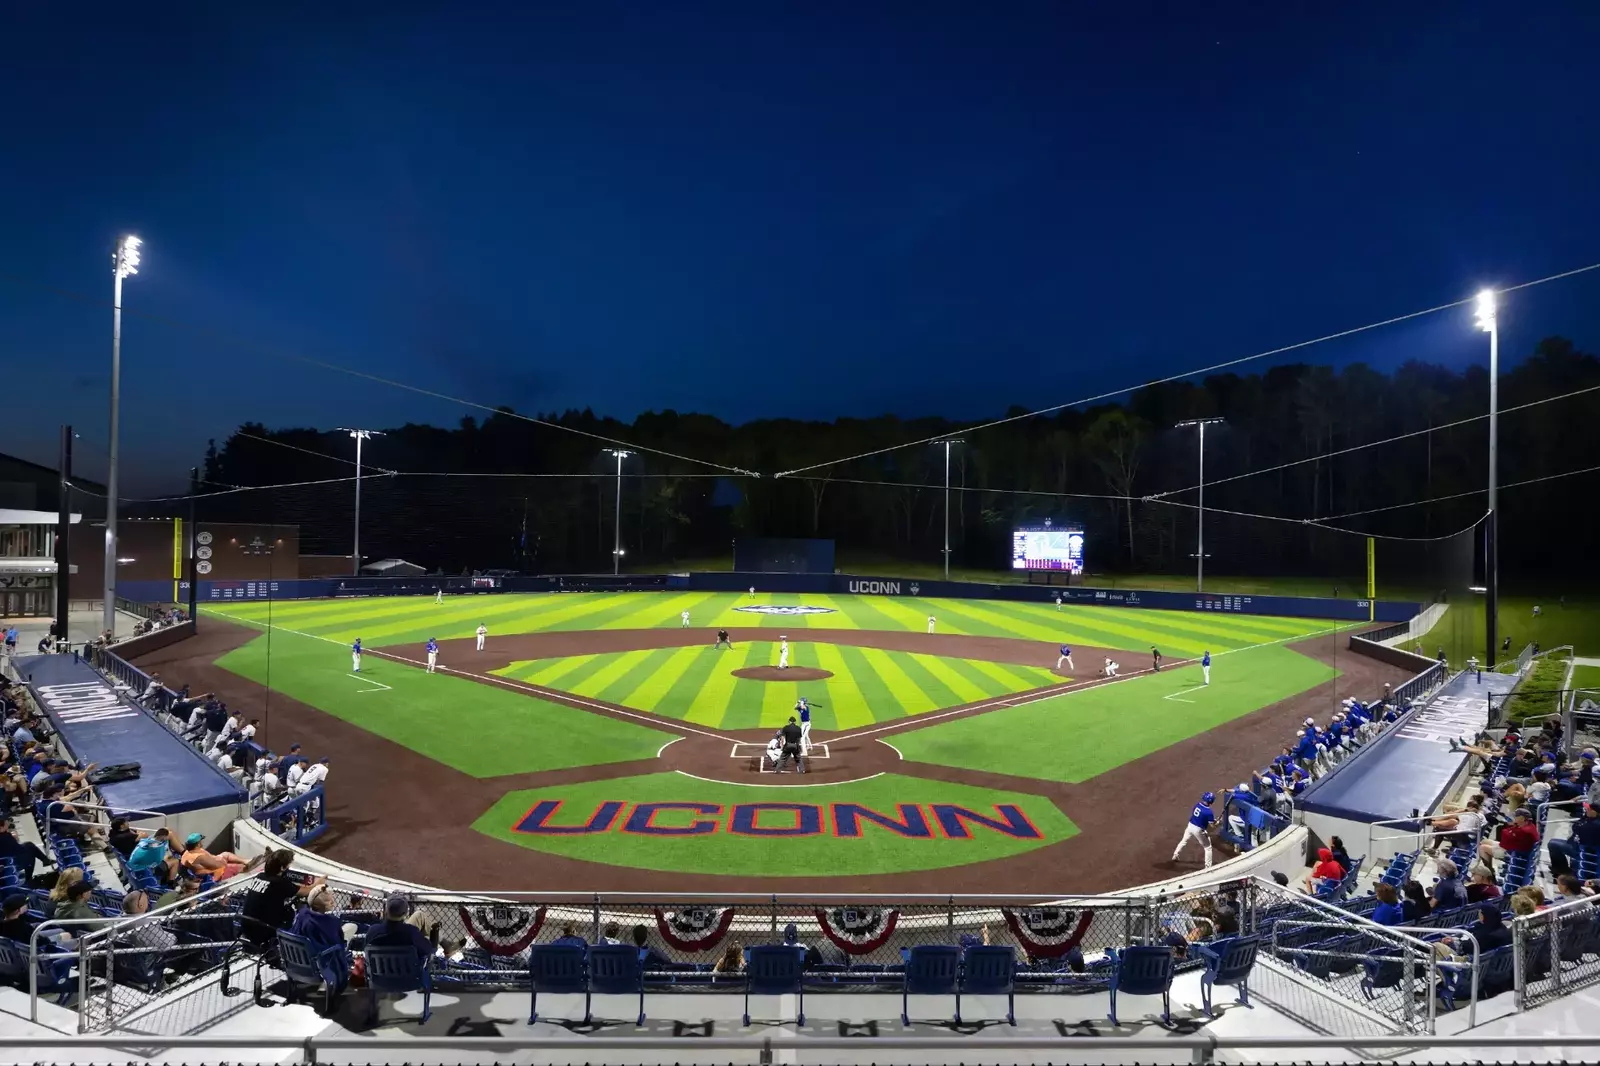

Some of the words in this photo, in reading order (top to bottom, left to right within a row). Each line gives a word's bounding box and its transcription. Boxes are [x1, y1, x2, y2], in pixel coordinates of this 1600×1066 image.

[849, 580, 900, 594] UCONN
[37, 681, 139, 724] UCONN
[1193, 806, 1202, 817] 6
[510, 799, 1046, 840] UCONN
[249, 877, 271, 894] STAFF
[307, 875, 313, 885] 3
